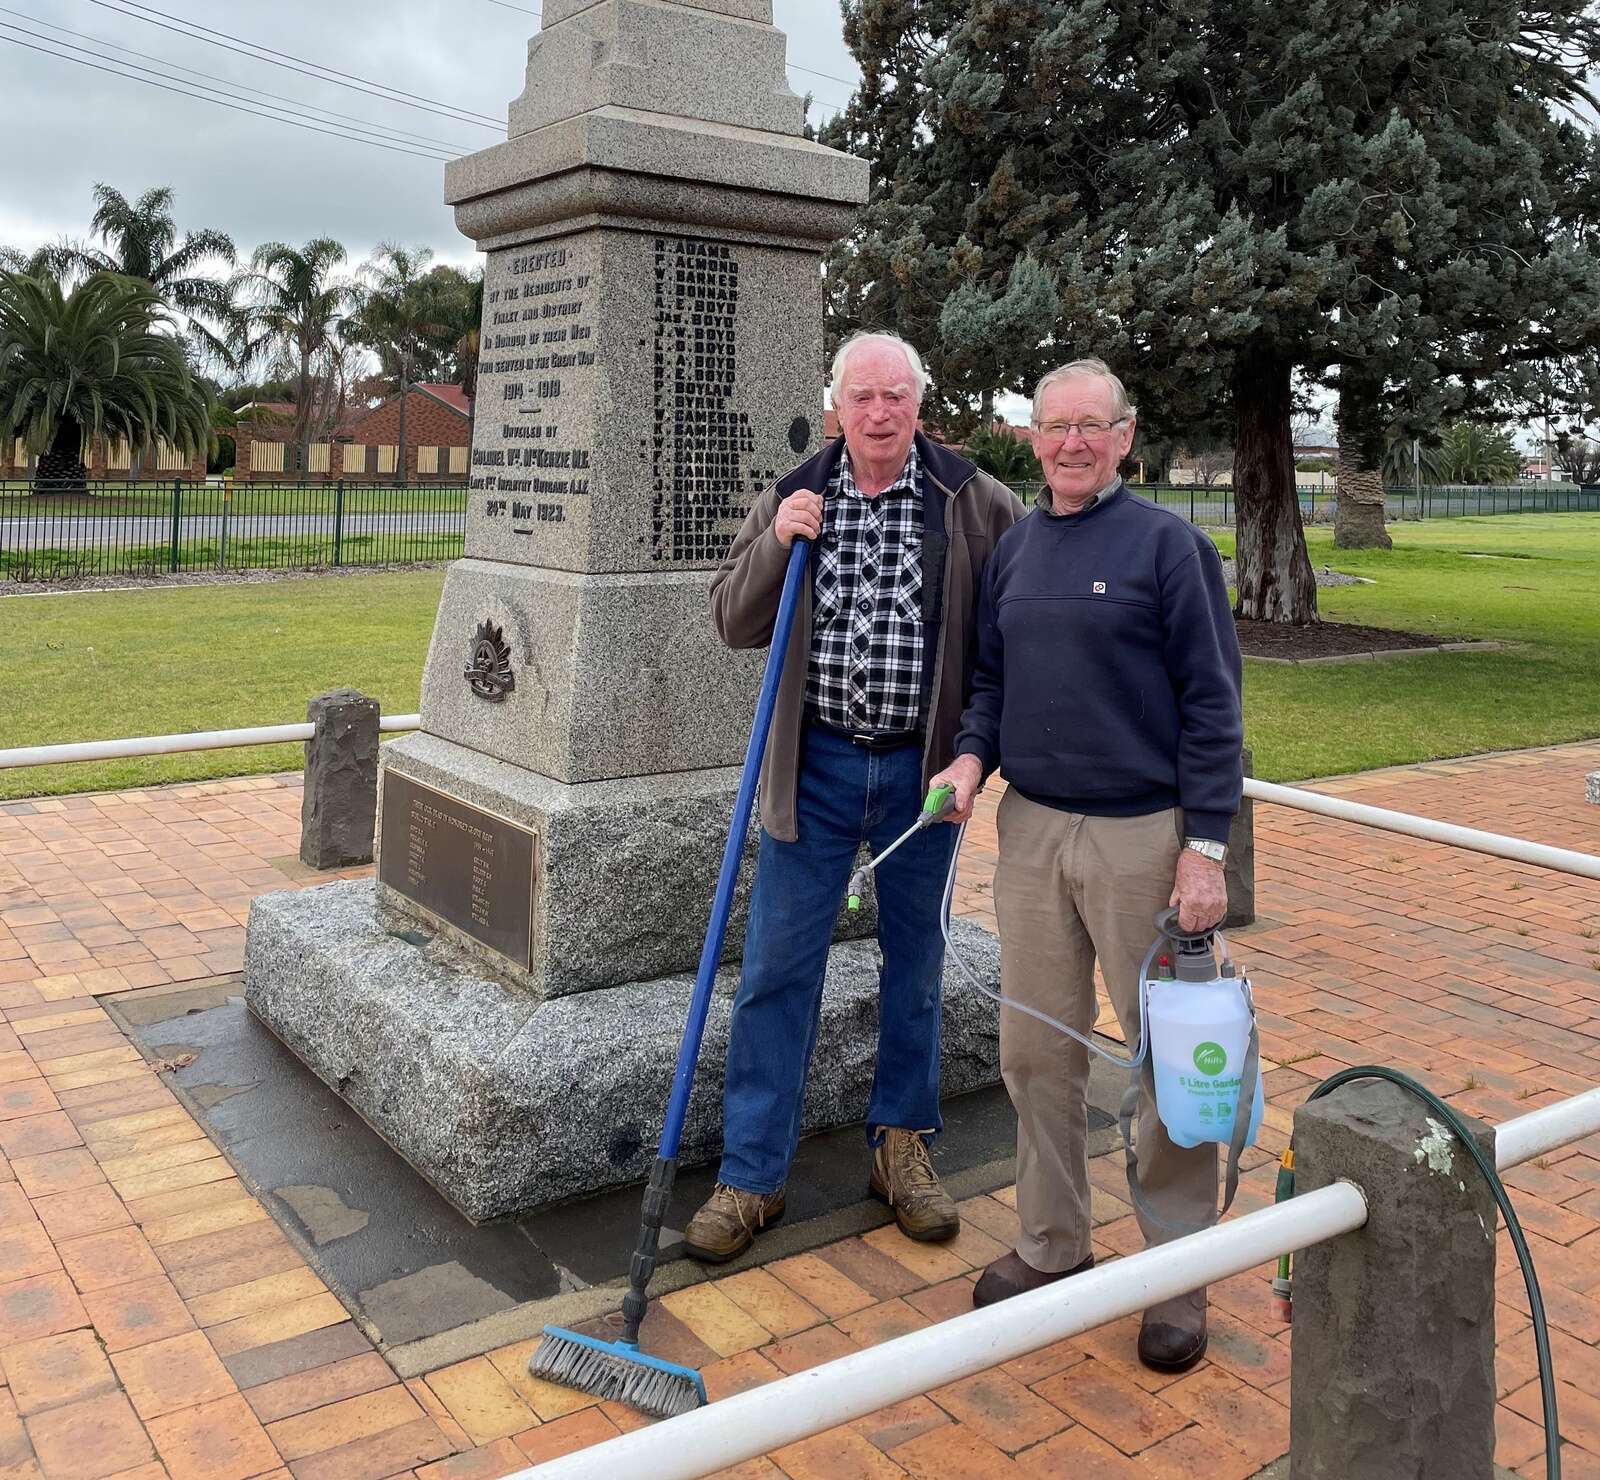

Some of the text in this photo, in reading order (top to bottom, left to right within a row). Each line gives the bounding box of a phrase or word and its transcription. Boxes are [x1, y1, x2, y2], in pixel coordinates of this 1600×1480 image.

[512, 248, 566, 275] ERECTED
[676, 256, 739, 274] ALMOND
[676, 270, 738, 288] BARNES
[489, 275, 590, 303] BY THE RESIDENTS OF
[676, 284, 738, 302] BONNAR
[522, 308, 539, 321] AND
[541, 302, 582, 319] DISTRICT
[694, 300, 736, 314] BOYD
[692, 314, 733, 328] BOYD
[494, 334, 526, 349] HONOUR
[529, 333, 540, 344] OF
[542, 329, 567, 344] THEIR
[570, 324, 591, 340] MEN
[694, 328, 735, 342] BOYD
[694, 342, 736, 356] BOYD
[494, 359, 524, 373] SERVED
[526, 358, 534, 370] IN
[534, 356, 550, 369] THE
[551, 352, 576, 368] GREAT
[577, 351, 595, 366] WAR
[694, 356, 736, 370] BOYD
[694, 369, 736, 382] BOYD
[504, 382, 524, 400] 1914
[675, 382, 732, 397] BOYLAN
[675, 396, 726, 410] BYRNE
[674, 410, 749, 424] CAMERON
[502, 424, 558, 438] UNVEILED BY
[674, 424, 755, 438] CAMPBELL
[674, 438, 756, 452] CAMPBELL
[472, 448, 505, 466] COLONEL
[674, 452, 740, 465] CANNING
[674, 466, 740, 479] CANNING
[470, 475, 485, 490] LATE
[498, 477, 532, 492] INFANTRY
[533, 478, 568, 494] BRIGADE
[674, 480, 745, 492] CHRISTIE
[674, 494, 730, 506] CLARKE
[512, 501, 532, 520] MAY
[674, 520, 714, 532] DENT
[674, 534, 738, 546] DOBINS
[1188, 1078, 1210, 1088] Litre
